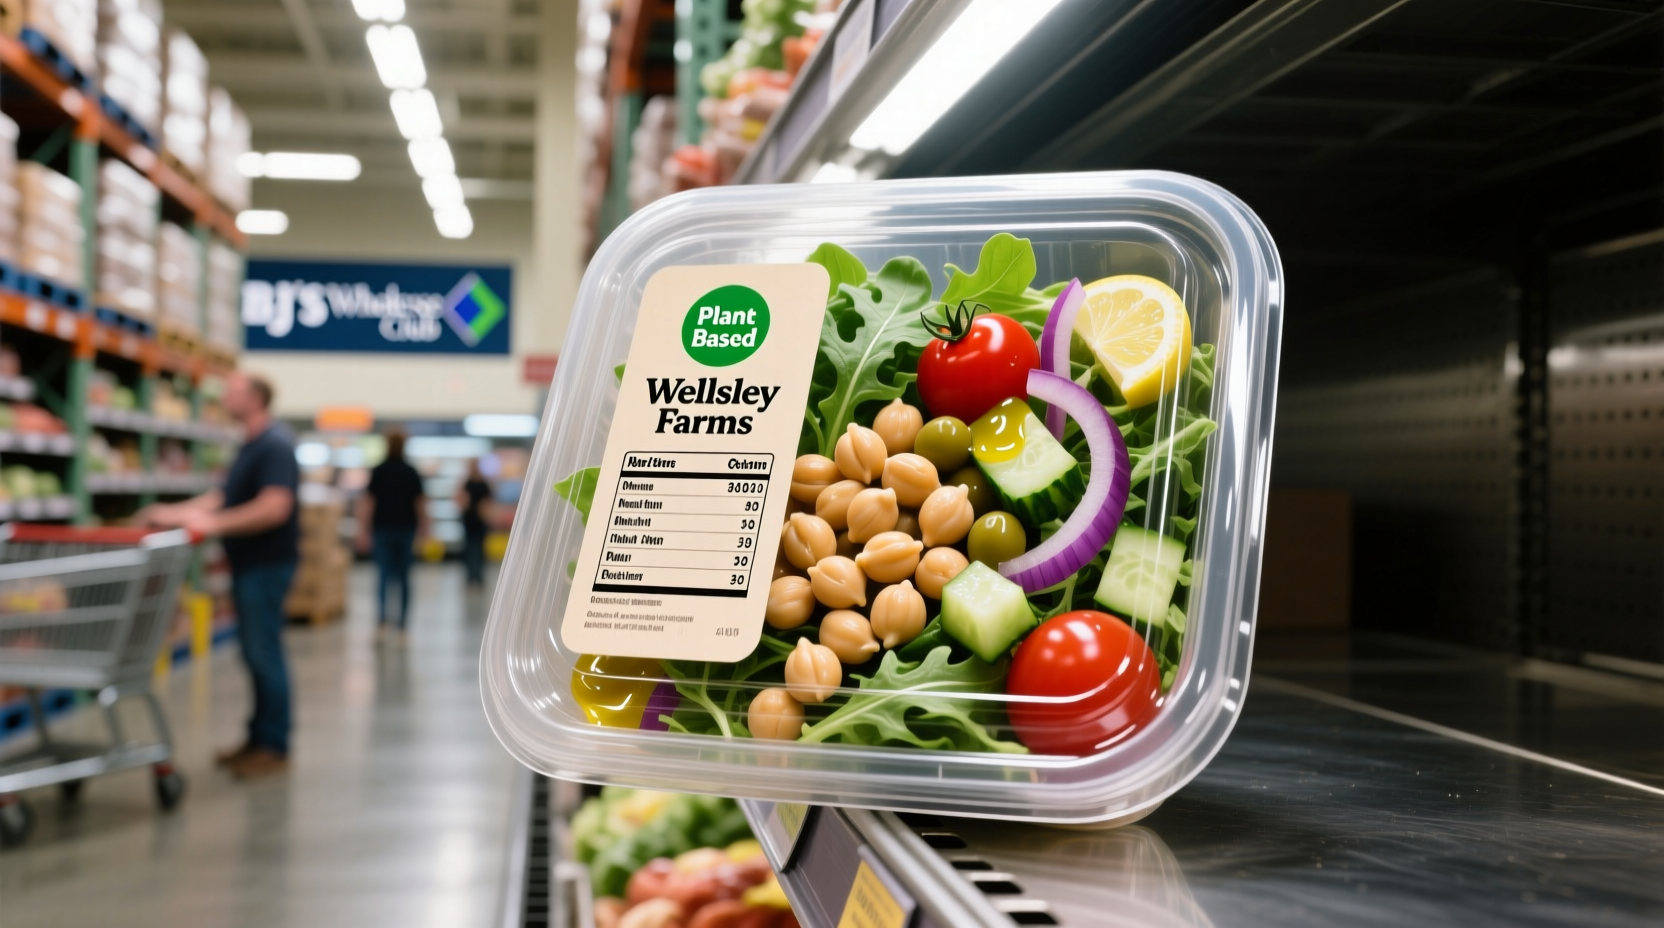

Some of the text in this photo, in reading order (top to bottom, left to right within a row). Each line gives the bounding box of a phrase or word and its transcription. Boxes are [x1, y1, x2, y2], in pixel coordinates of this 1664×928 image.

[697, 305, 757, 326] Plant
[691, 327, 758, 348] Based
[646, 377, 781, 413] Wellsley
[654, 407, 754, 435] Farms
